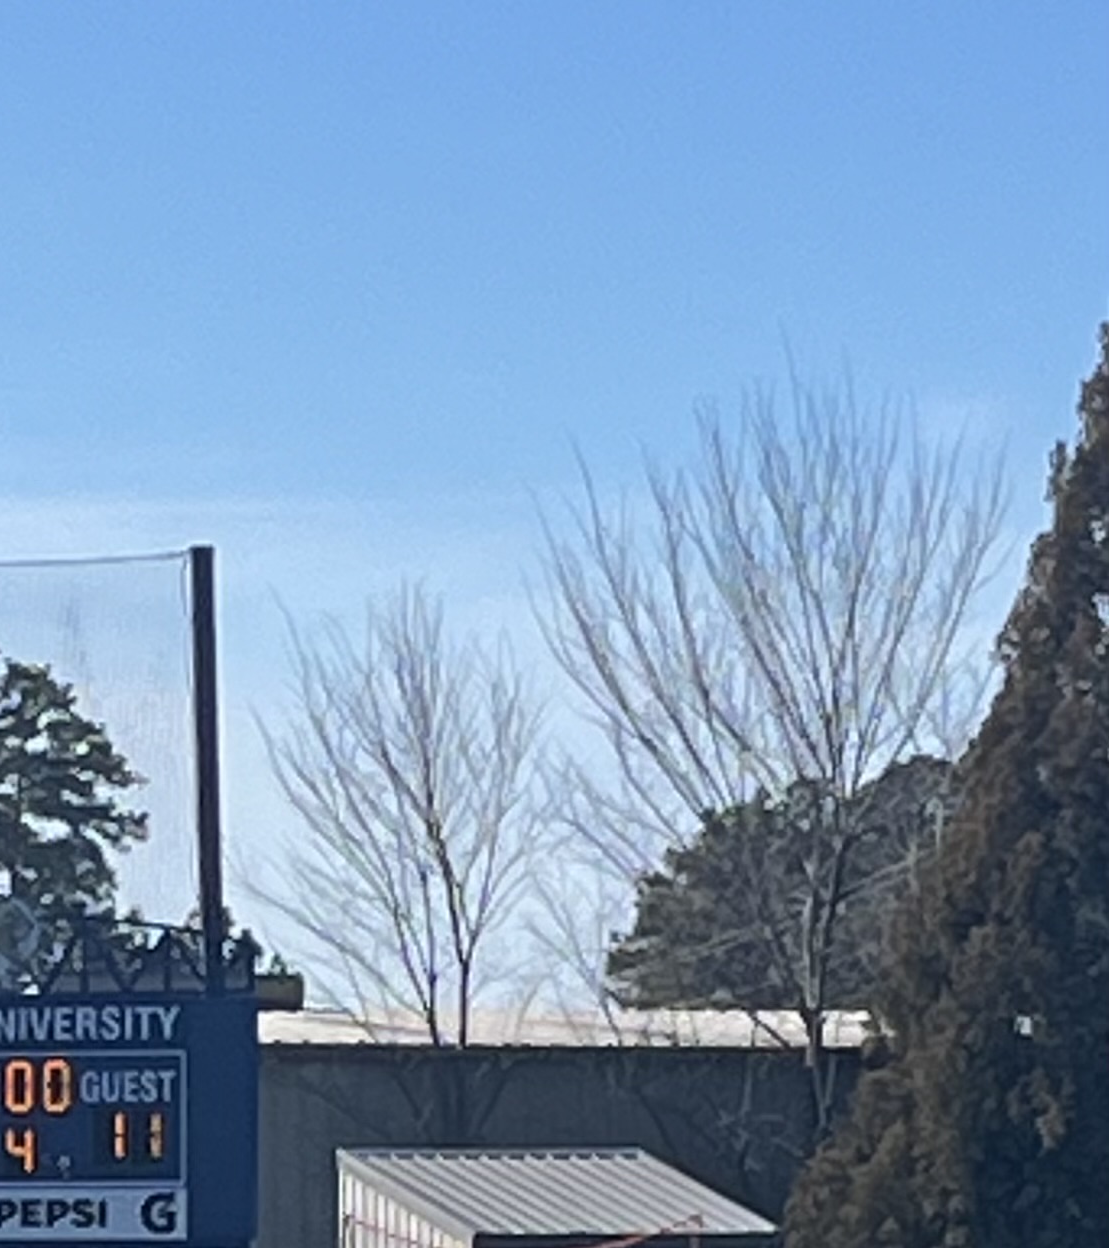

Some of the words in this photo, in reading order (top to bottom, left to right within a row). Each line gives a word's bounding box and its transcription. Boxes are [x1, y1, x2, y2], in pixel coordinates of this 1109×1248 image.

[79, 1070, 177, 1102] GUEST
[5, 1127, 35, 1173] 4
[114, 1111, 162, 1158] 11
[140, 1192, 177, 1234] G
